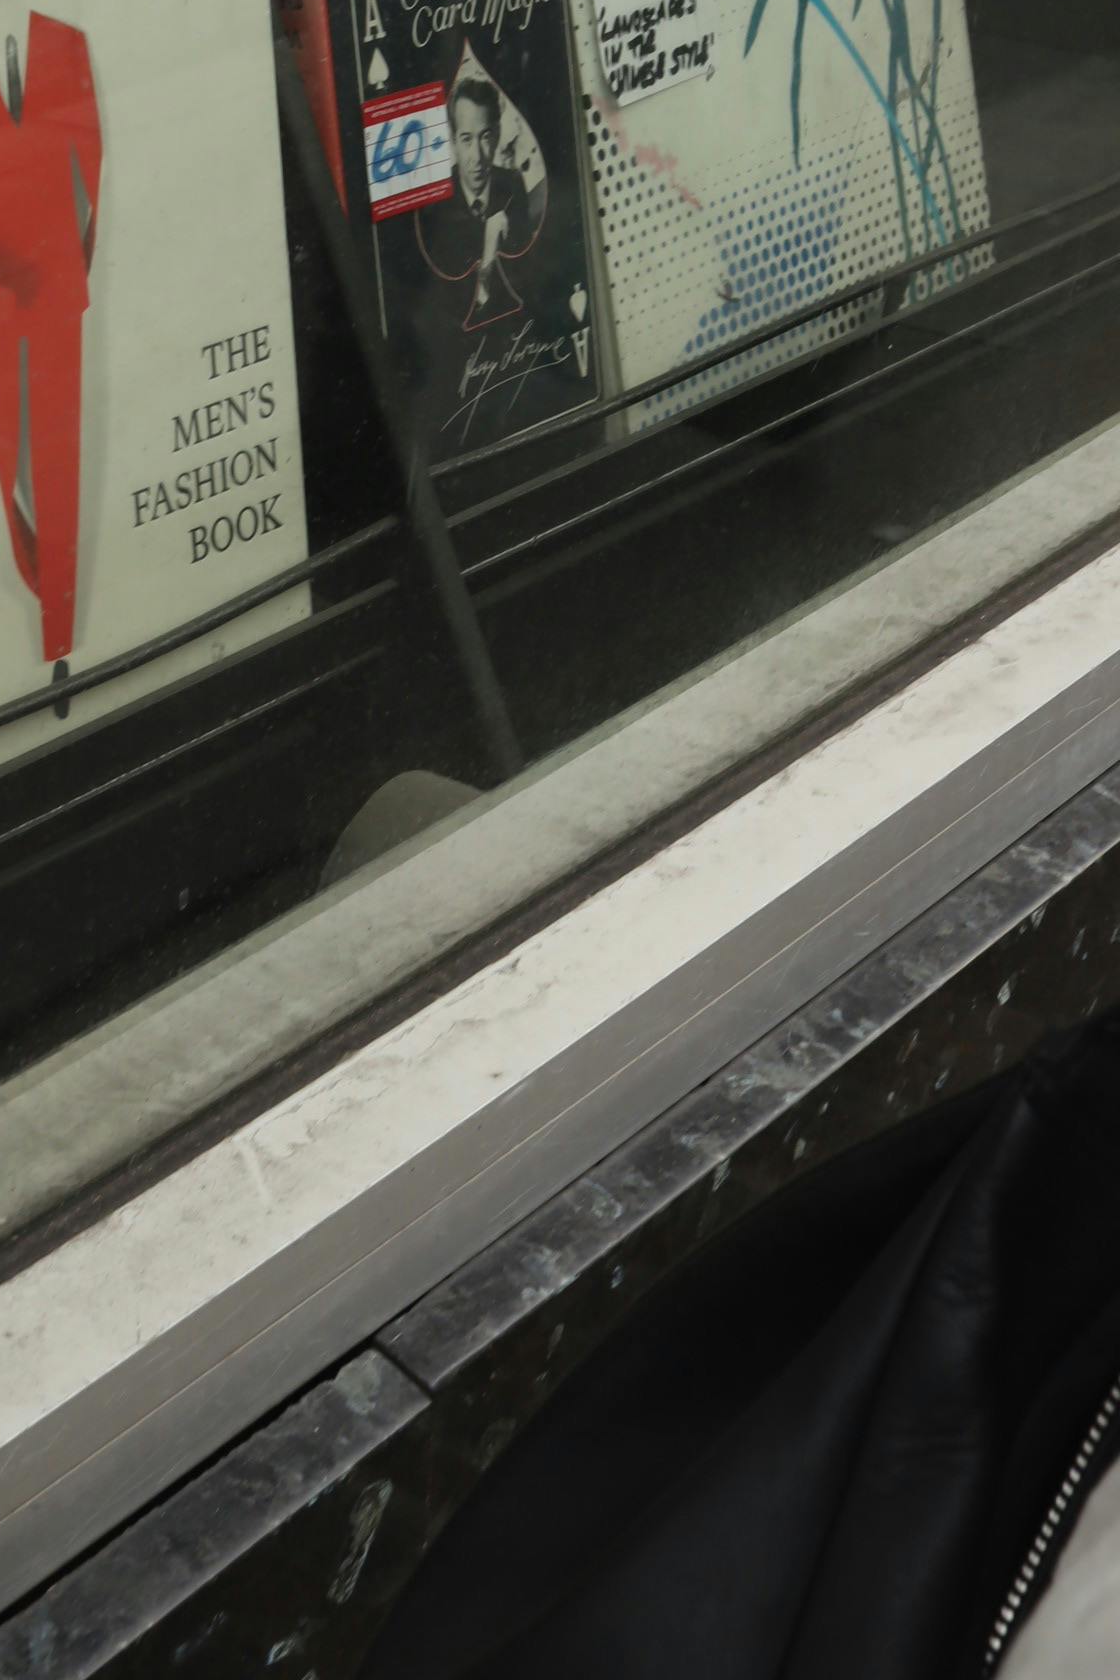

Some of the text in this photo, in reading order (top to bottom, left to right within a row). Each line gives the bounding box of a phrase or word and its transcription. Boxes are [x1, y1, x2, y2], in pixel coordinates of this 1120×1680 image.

[201, 324, 272, 380] THE
[171, 381, 275, 453] MEN'S
[131, 436, 280, 528] FASHION
[188, 493, 283, 564] BOOK
